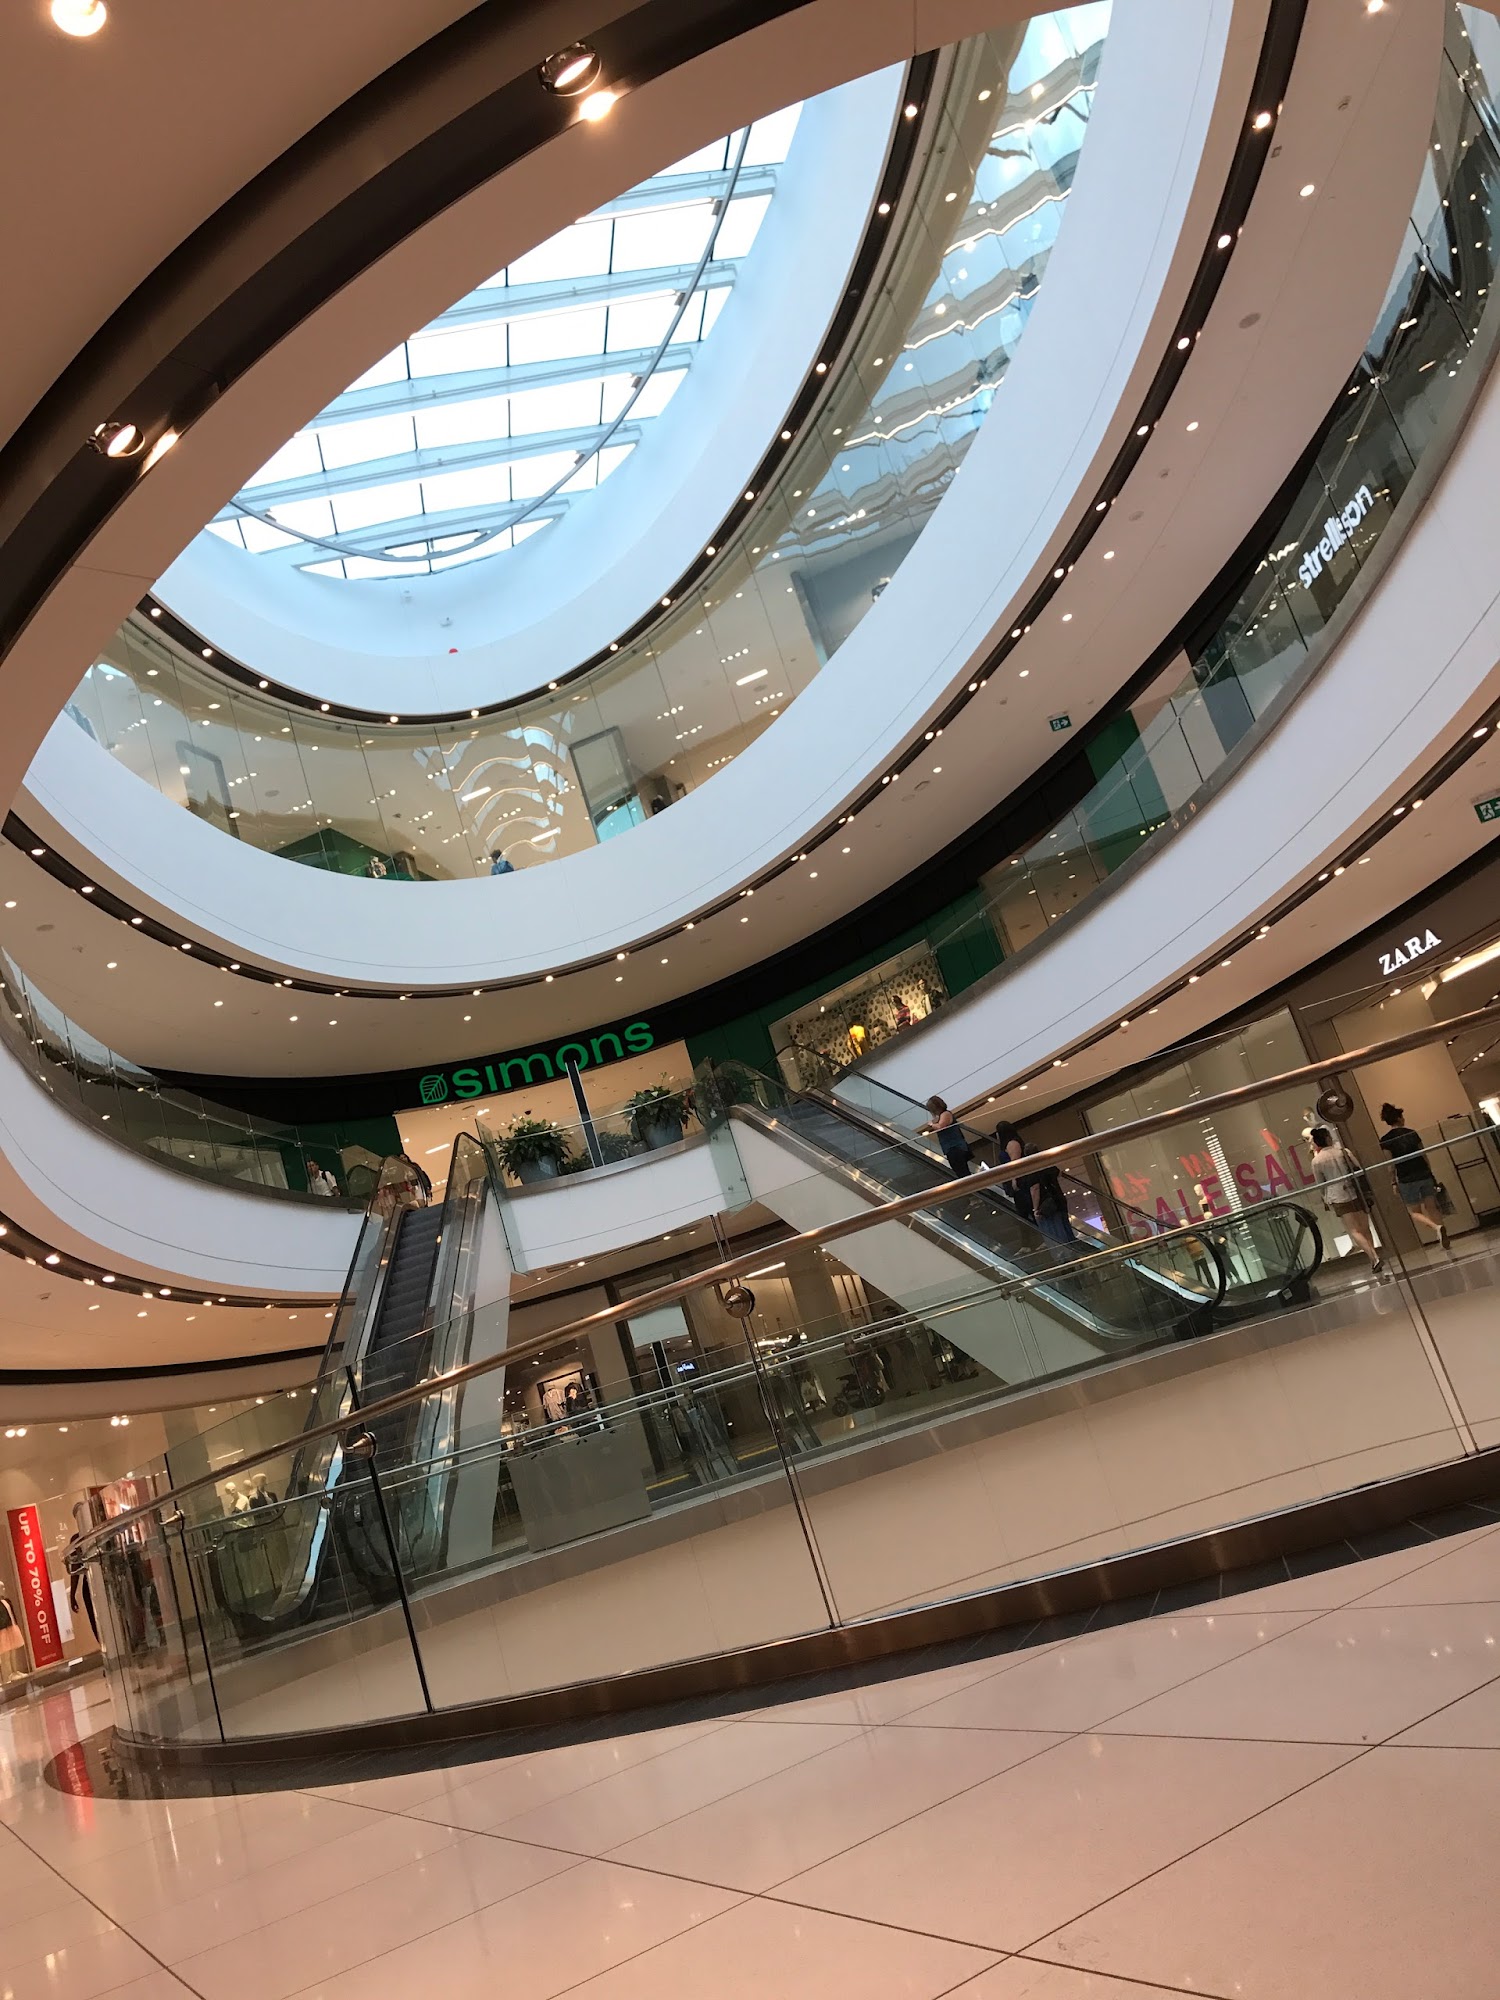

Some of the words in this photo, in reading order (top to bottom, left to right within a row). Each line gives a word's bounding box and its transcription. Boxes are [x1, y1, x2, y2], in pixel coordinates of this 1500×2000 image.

[1298, 484, 1375, 590] strellson
[1379, 929, 1442, 976] ZARA
[452, 1021, 655, 1099] simons
[1126, 1175, 1233, 1242] SALE
[1235, 1145, 1317, 1204] SAL
[18, 1512, 31, 1537] UP
[24, 1539, 36, 1564] TO
[28, 1566, 44, 1607] 70%
[37, 1610, 51, 1644] OFF
